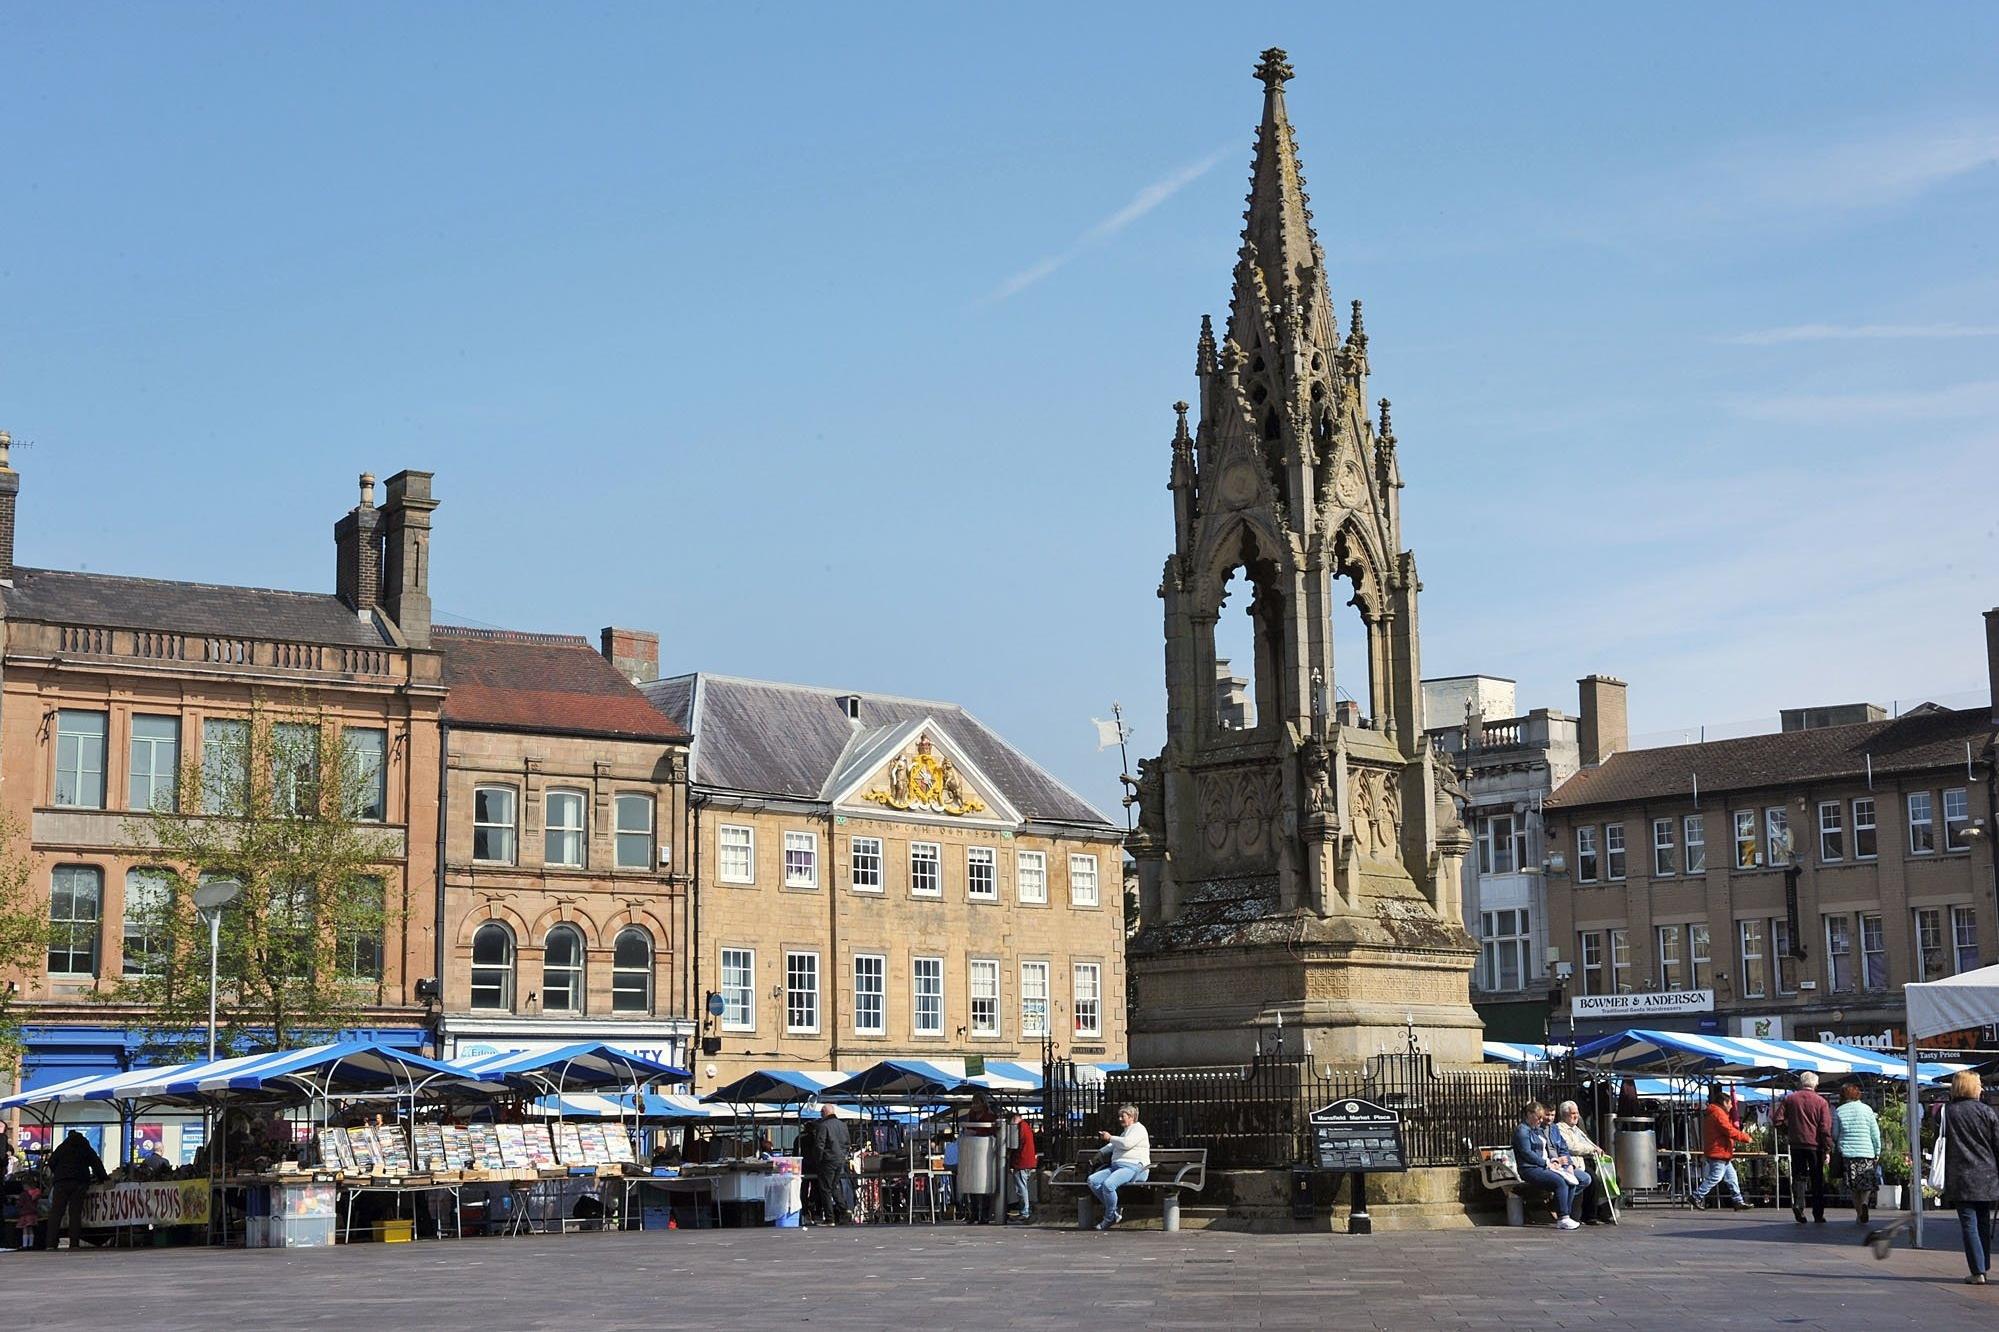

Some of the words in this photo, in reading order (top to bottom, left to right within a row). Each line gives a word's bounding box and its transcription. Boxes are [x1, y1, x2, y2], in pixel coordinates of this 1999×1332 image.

[1580, 997, 1629, 1008] BOWMER
[1632, 995, 1640, 1006] &
[1643, 992, 1706, 1006] ANDERSON
[109, 1188, 145, 1221] BOOKS
[154, 1187, 182, 1219] TOYS
